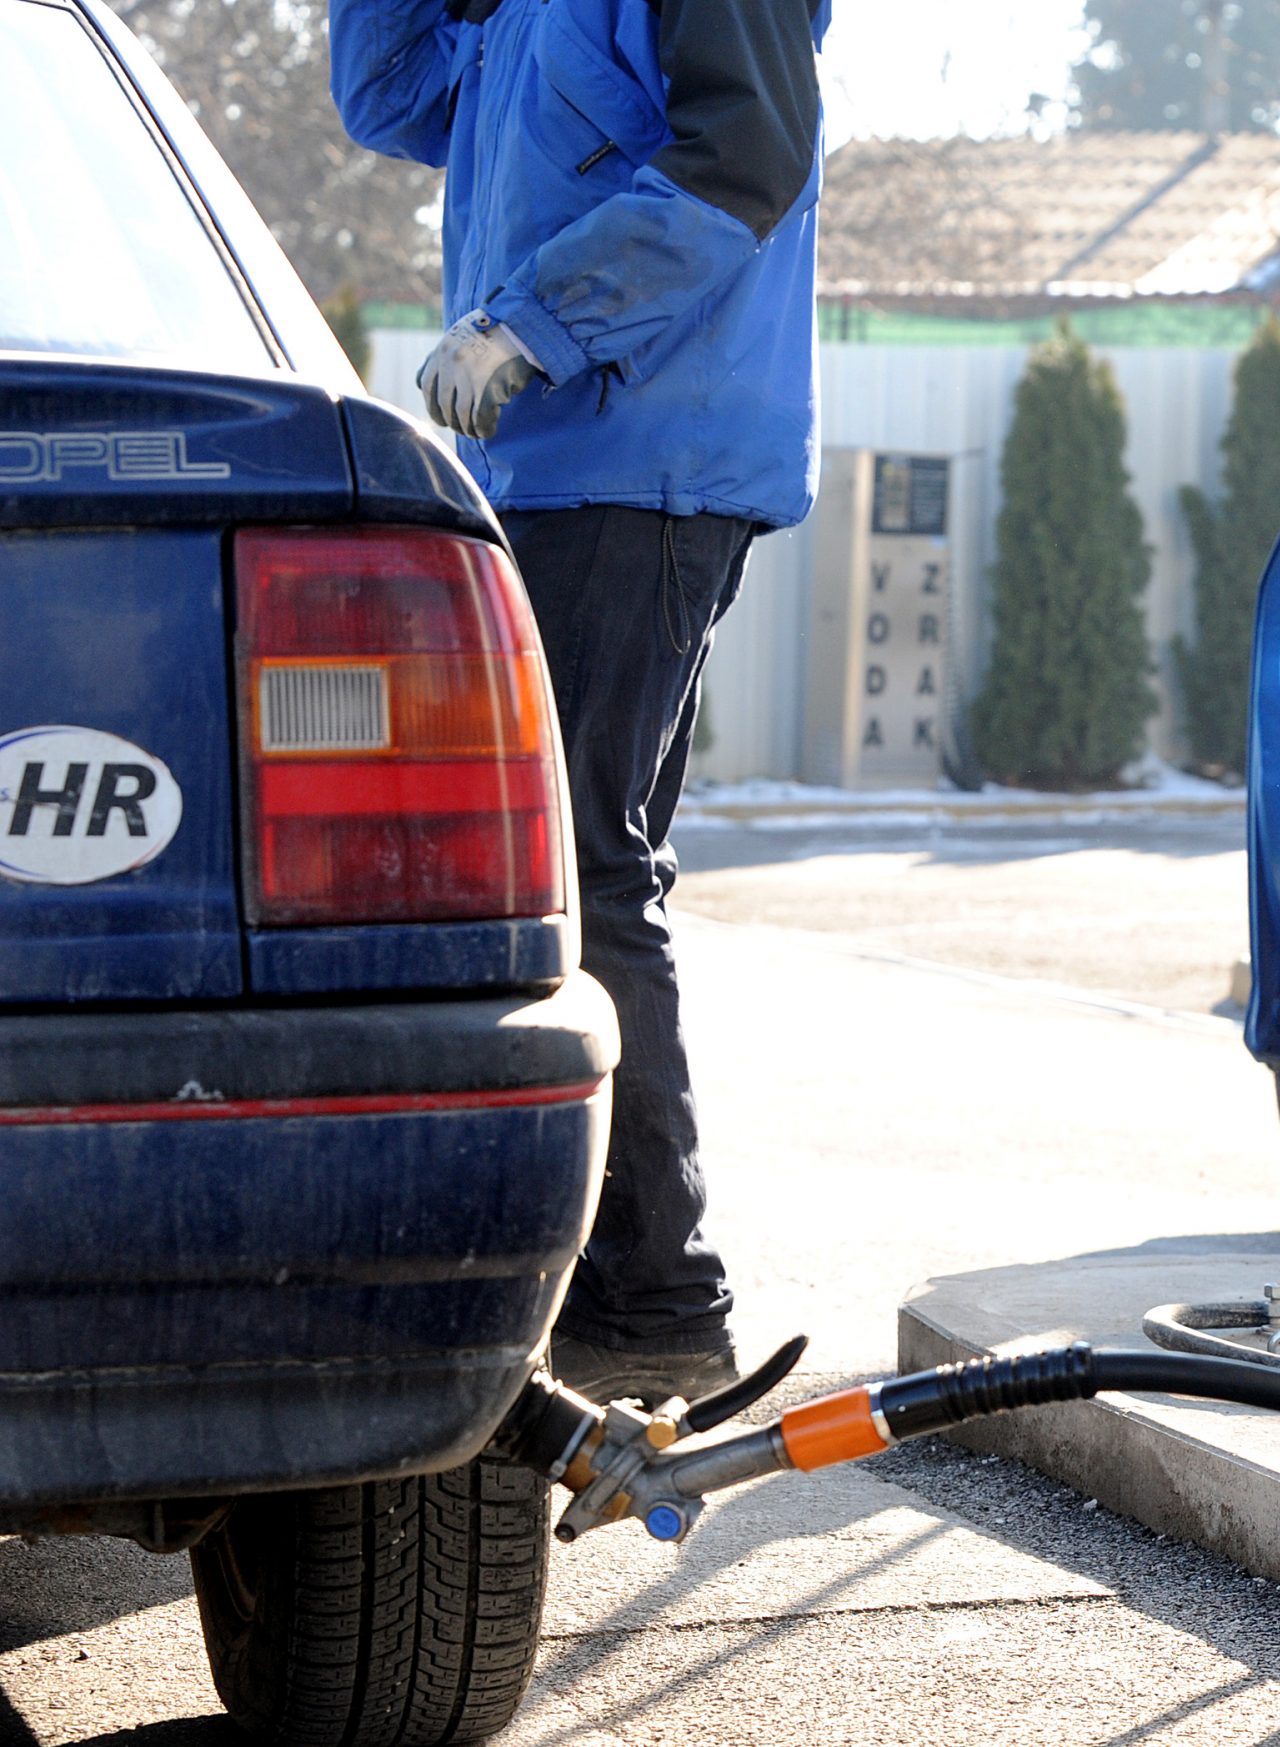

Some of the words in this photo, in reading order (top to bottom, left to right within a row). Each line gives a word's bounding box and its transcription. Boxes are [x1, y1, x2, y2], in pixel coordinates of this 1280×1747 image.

[865, 564, 890, 745] VODA
[914, 564, 941, 746] ZRAK
[8, 762, 157, 837] HR
